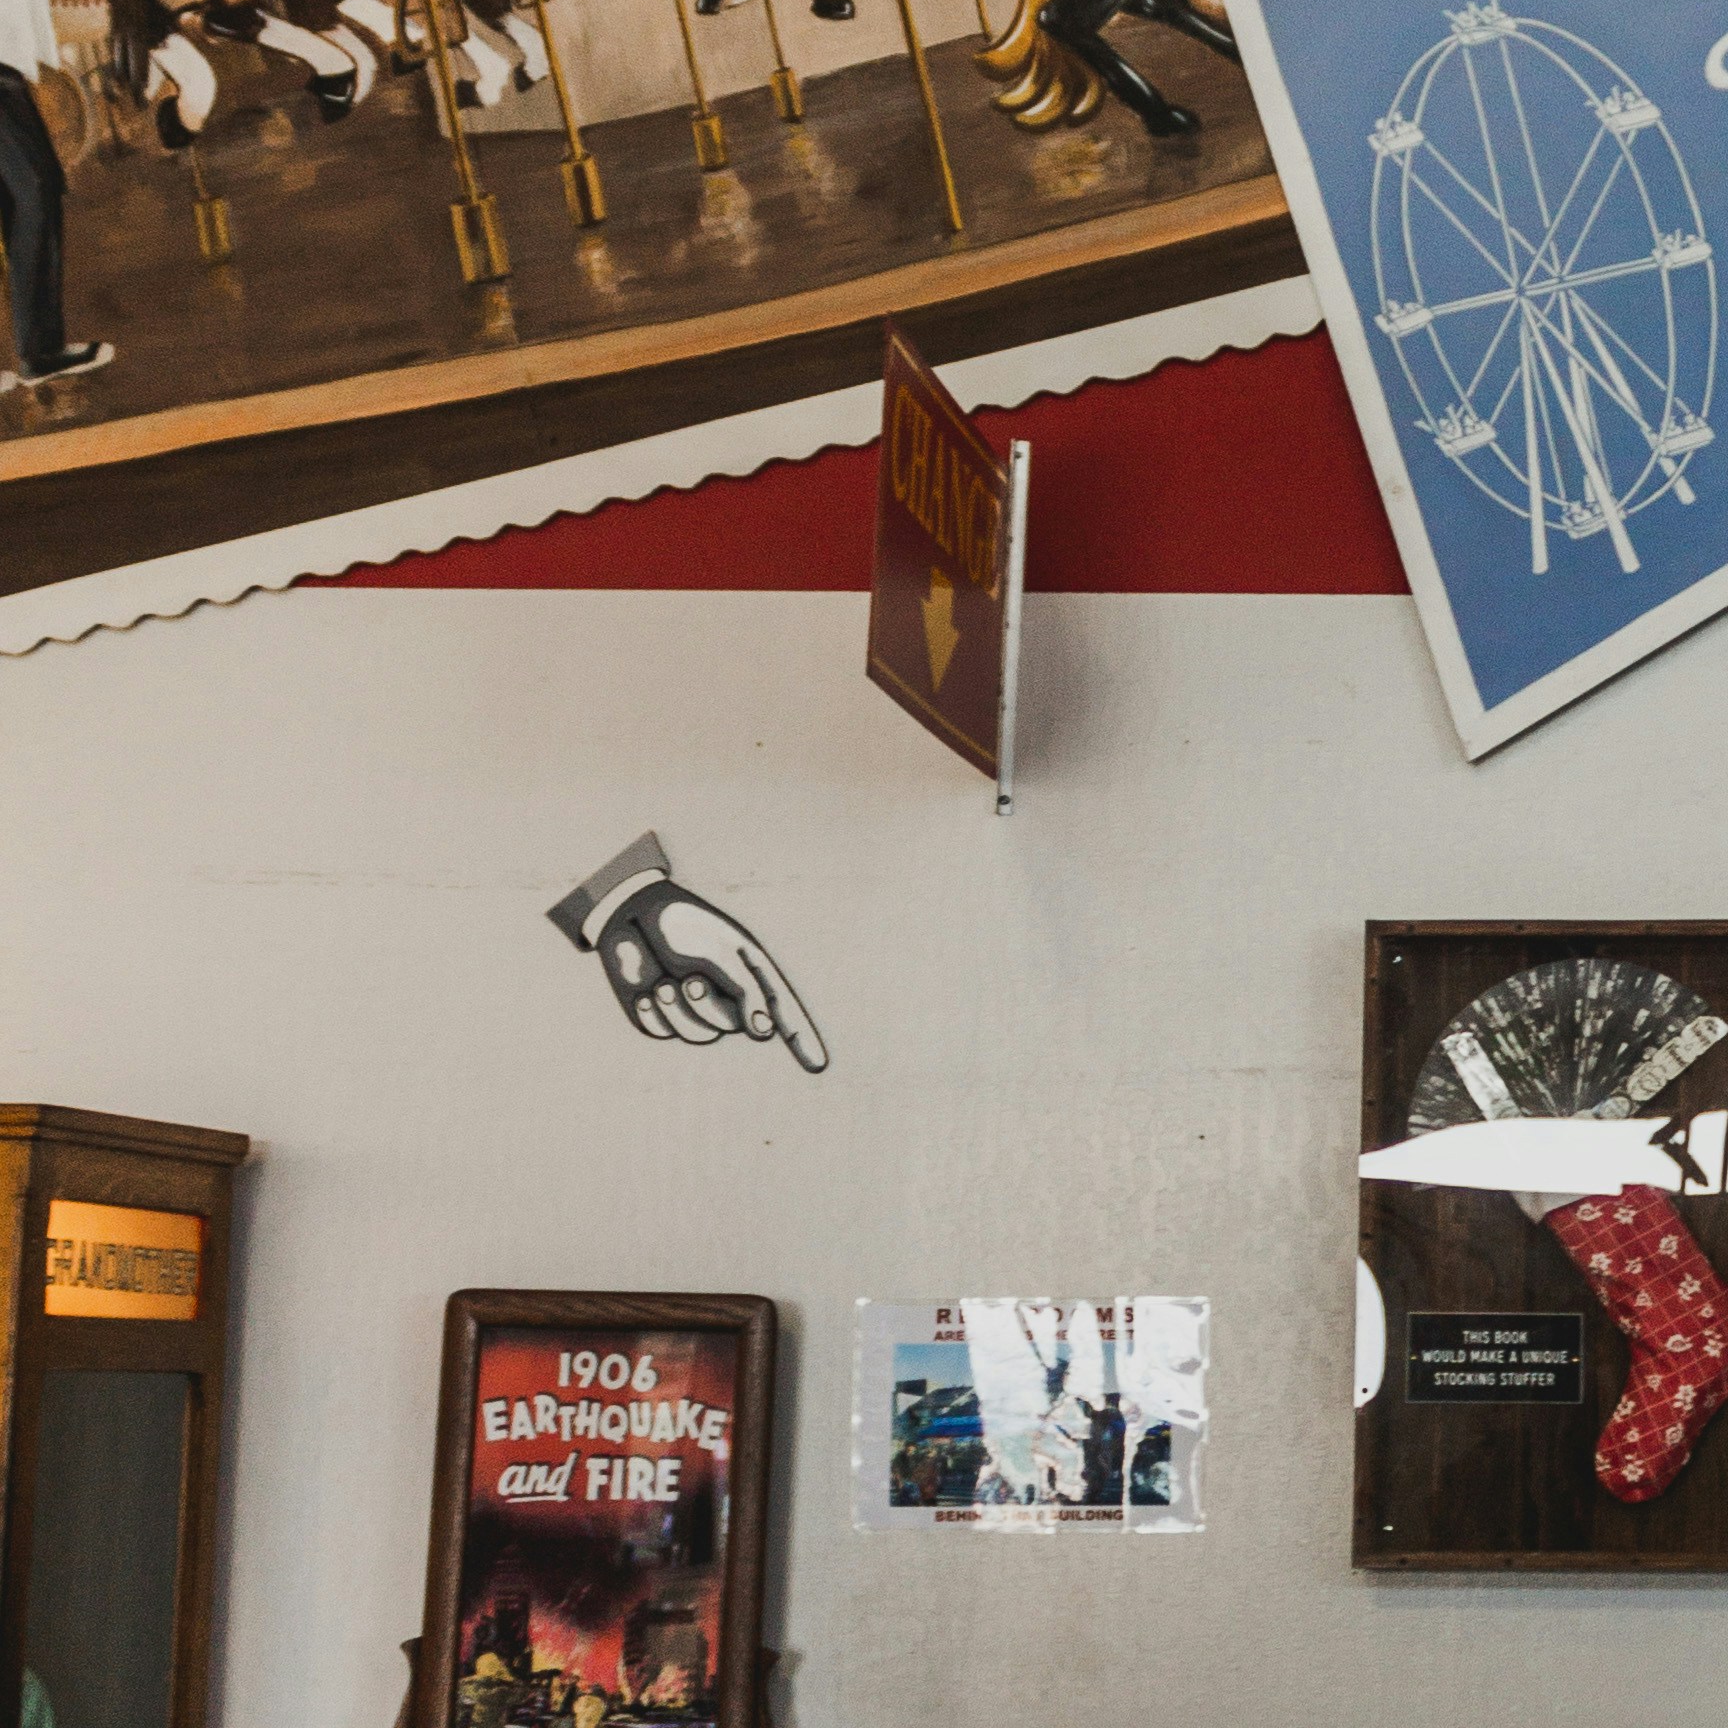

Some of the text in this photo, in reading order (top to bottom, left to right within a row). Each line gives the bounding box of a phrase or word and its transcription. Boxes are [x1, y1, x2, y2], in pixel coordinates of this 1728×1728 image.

[1462, 1330, 1529, 1345] THIS BOOK
[557, 1350, 659, 1393] 1906
[1421, 1349, 1569, 1365] WOULD MAKE A UNIQUE
[1433, 1371, 1556, 1387] STOCKING STUFFER
[482, 1395, 731, 1453] EARTHQUAKE
[497, 1450, 682, 1504] and FIRE
